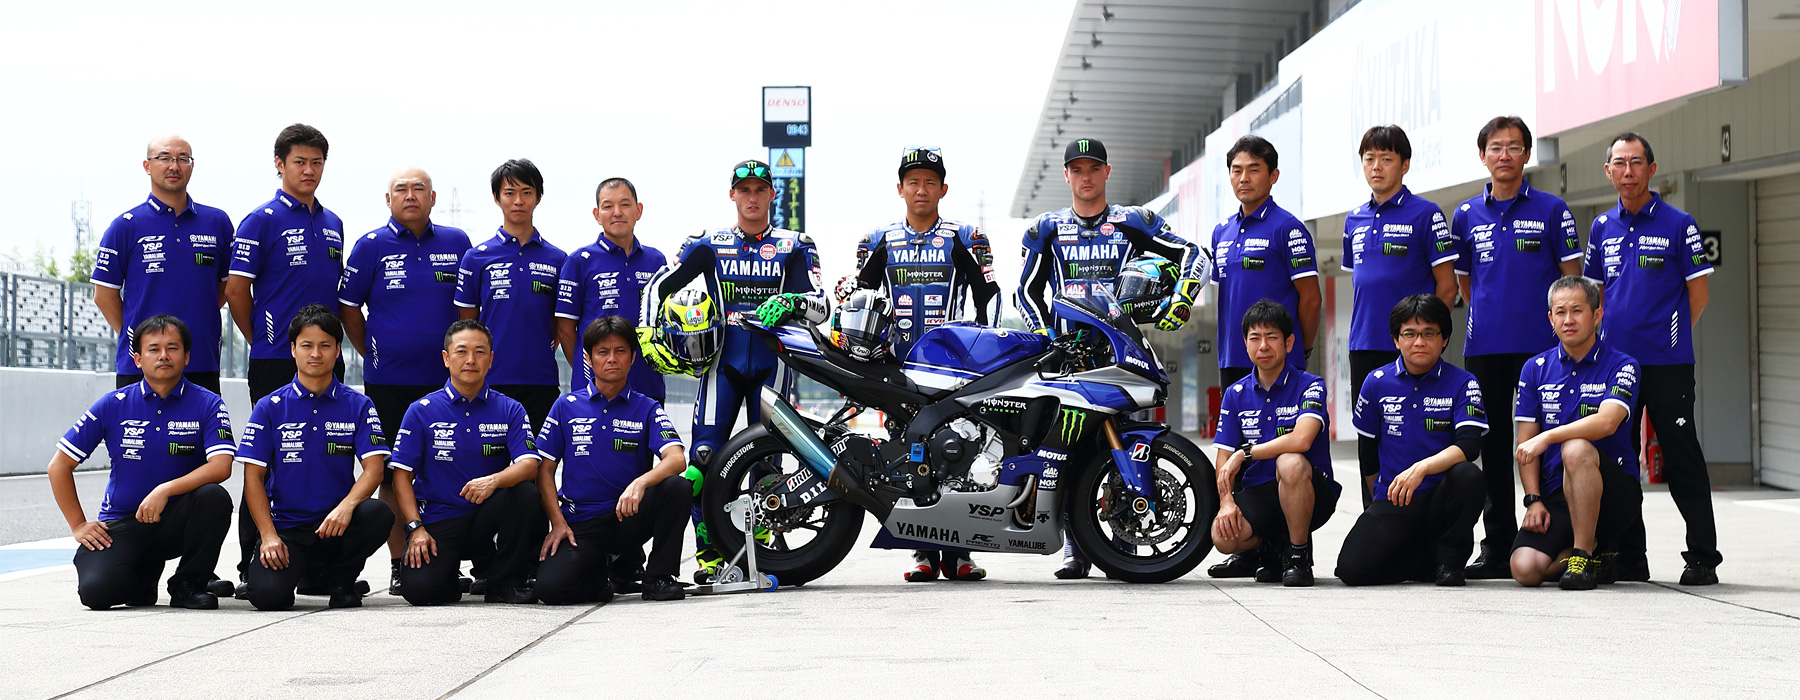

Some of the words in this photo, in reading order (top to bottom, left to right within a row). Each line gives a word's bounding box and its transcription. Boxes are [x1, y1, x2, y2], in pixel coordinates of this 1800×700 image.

[767, 98, 806, 107] DENSO
[1390, 224, 1413, 234] YAMAHA
[1520, 220, 1545, 230] YAMAHA
[286, 235, 304, 244] YSP
[1474, 231, 1492, 241] YSP
[1288, 238, 1307, 247] MOTUL
[1645, 236, 1670, 247] YAMAHA
[142, 242, 163, 251] YSP
[1604, 245, 1621, 254] YSP
[893, 249, 945, 263] YAMAHA
[1061, 244, 1119, 260] YAMAHA
[535, 263, 557, 273] YAMAHA
[720, 260, 781, 277] YAMAHA
[1079, 264, 1112, 272] MONSTER
[490, 269, 510, 278] YSP
[598, 279, 617, 288] YSP
[735, 286, 779, 295] MONSTER
[1125, 355, 1150, 370] MOTUL
[1615, 371, 1637, 383] MOTUL
[1541, 391, 1560, 400] YSP
[983, 398, 1026, 410] MONSTER
[1431, 397, 1453, 406] YAMAHA
[1383, 404, 1402, 412] YSP
[619, 420, 644, 429] YAMAHA
[1241, 418, 1259, 426] YSP
[124, 427, 145, 436] YSP
[572, 424, 592, 433] YSP
[281, 431, 303, 439] YSP
[433, 429, 455, 438] YSP
[1037, 449, 1067, 461] MOTUL
[1163, 443, 1194, 467] BRIDGESTONE
[720, 441, 755, 479] BRIDGESTONE
[968, 503, 1004, 517] YSP
[896, 522, 960, 543] YAMAHA
[1008, 539, 1046, 550] YAMALUBE
